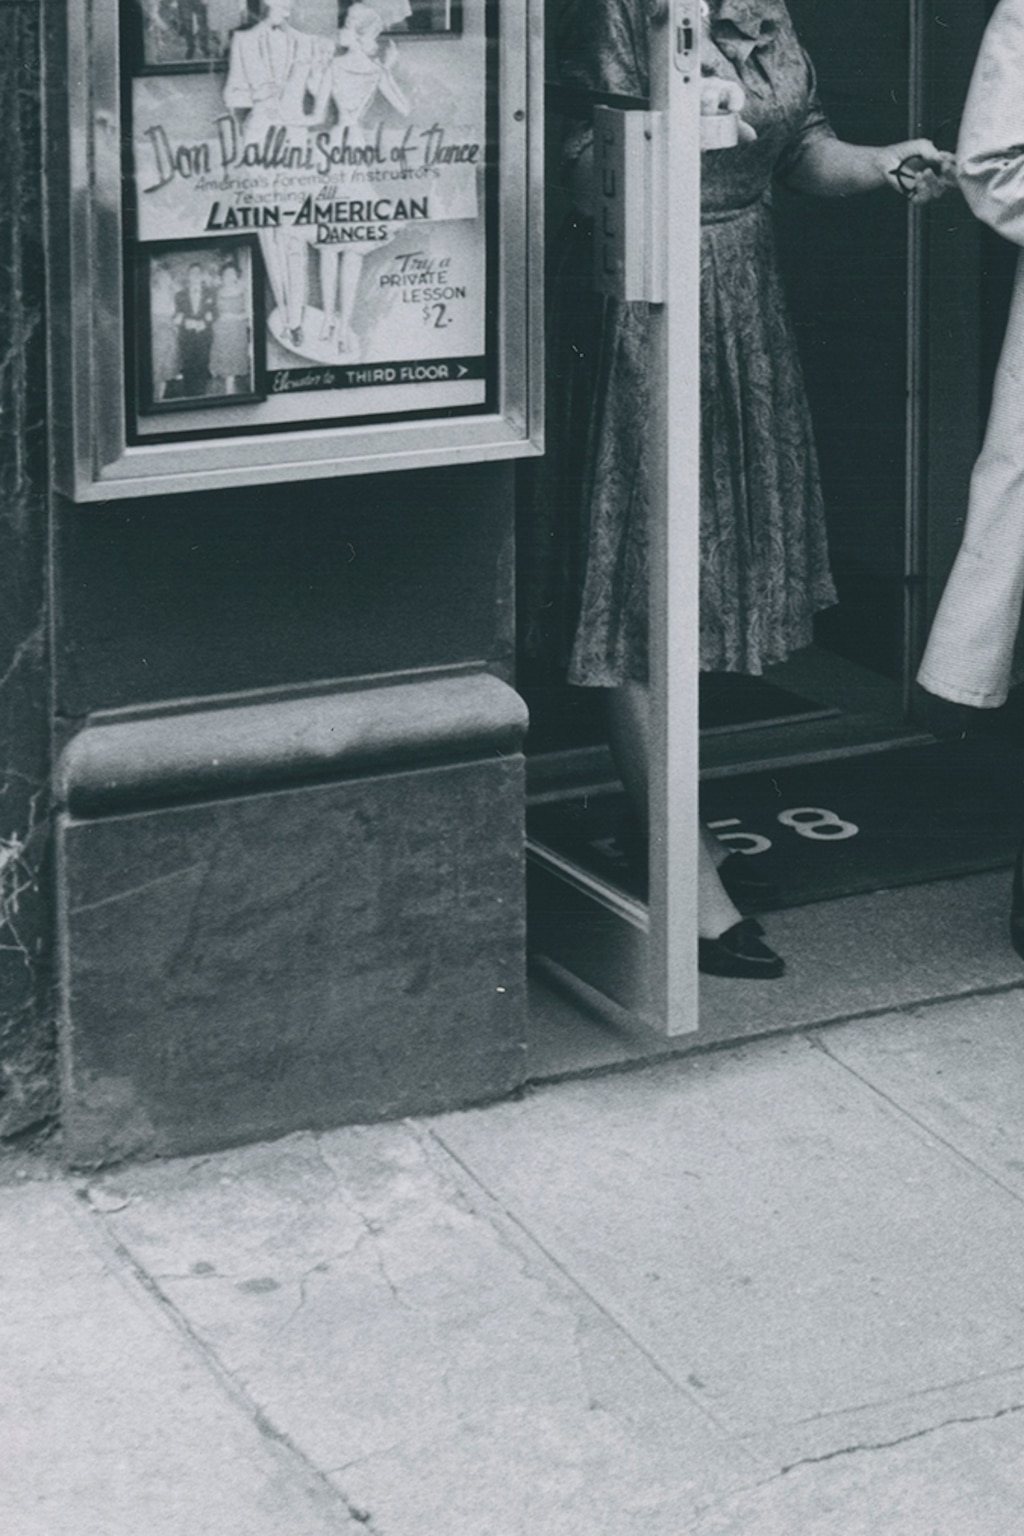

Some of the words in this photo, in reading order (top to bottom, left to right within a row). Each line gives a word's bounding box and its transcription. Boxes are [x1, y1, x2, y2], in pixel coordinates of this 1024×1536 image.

[143, 125, 210, 193] Don
[214, 114, 313, 174] Pallini
[316, 122, 382, 174] School
[390, 124, 417, 166] of
[421, 123, 480, 165] Dance
[194, 172, 268, 192] America's
[273, 170, 345, 188] Foremost
[351, 165, 440, 184] Instructors
[234, 188, 305, 205] Teaching
[204, 195, 428, 231] LATIN-AMERICAN
[316, 224, 388, 244] DANCES
[395, 251, 433, 274] Try
[440, 257, 450, 268] a
[380, 271, 448, 288] PRIVATE
[402, 286, 466, 303] LESSON
[346, 368, 396, 384] THIRD
[400, 365, 449, 381] FLOOR
